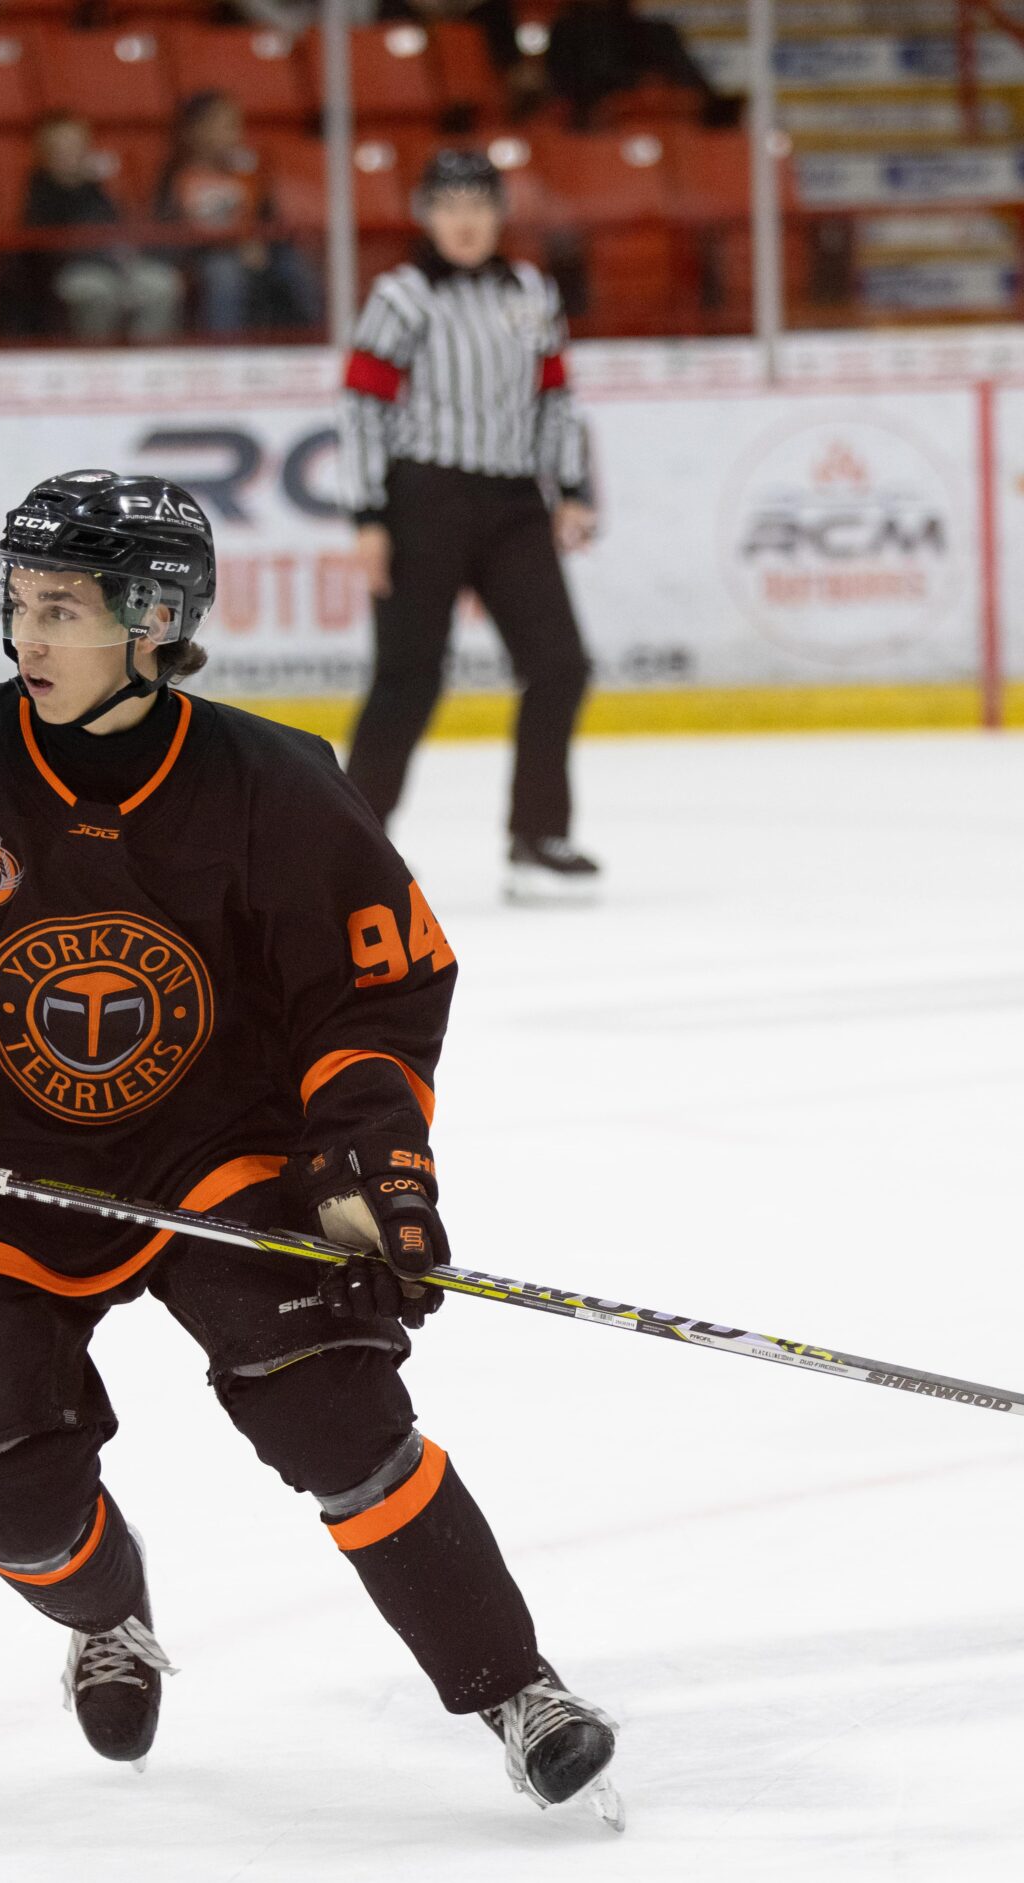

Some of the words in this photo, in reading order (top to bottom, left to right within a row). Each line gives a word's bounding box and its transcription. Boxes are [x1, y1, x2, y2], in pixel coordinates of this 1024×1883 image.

[14, 515, 61, 532] CCM
[119, 496, 205, 525] PAC
[150, 560, 190, 574] CCM
[130, 626, 148, 635] CCM
[347, 879, 456, 988] 94
[2, 927, 193, 996] YORKTON
[5, 1033, 184, 1112] TERRIERS
[865, 1370, 1013, 1412] SHERWOOD
